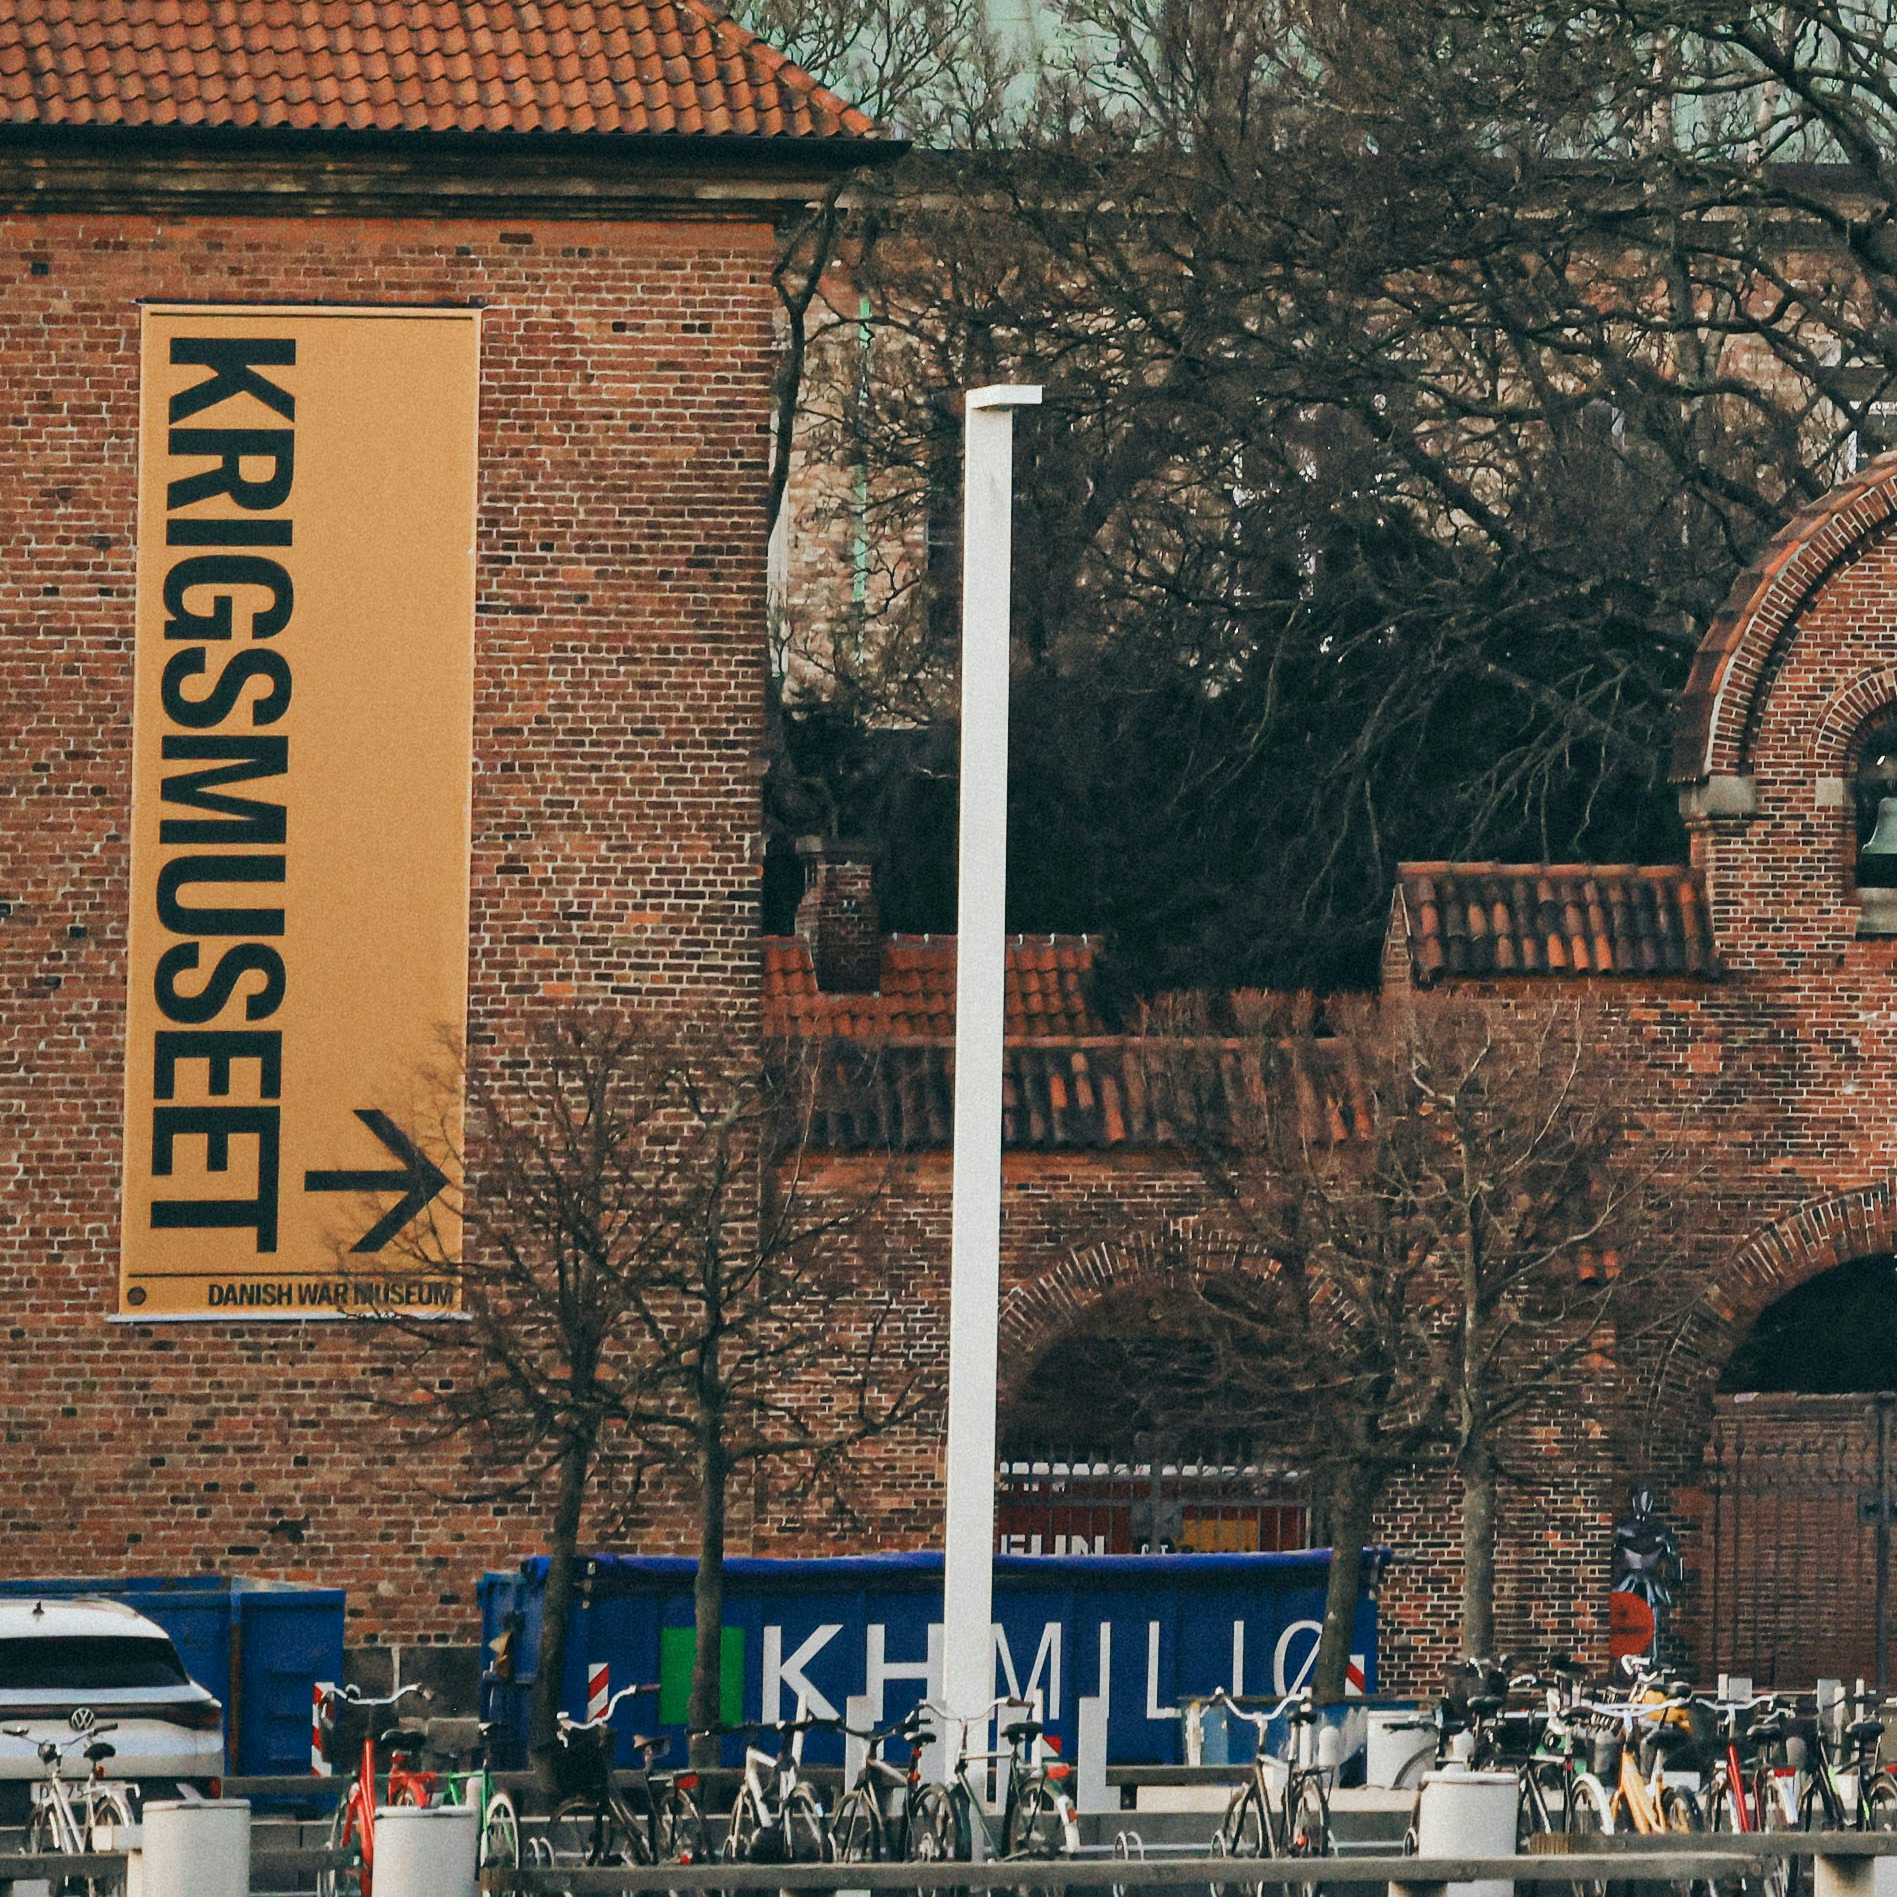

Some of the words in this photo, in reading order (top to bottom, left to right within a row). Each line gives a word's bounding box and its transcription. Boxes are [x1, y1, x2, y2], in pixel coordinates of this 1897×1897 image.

[149, 337, 297, 1253] KRIGSMUSEET
[208, 1282, 293, 1307] DANISH
[298, 1282, 348, 1306] WAR
